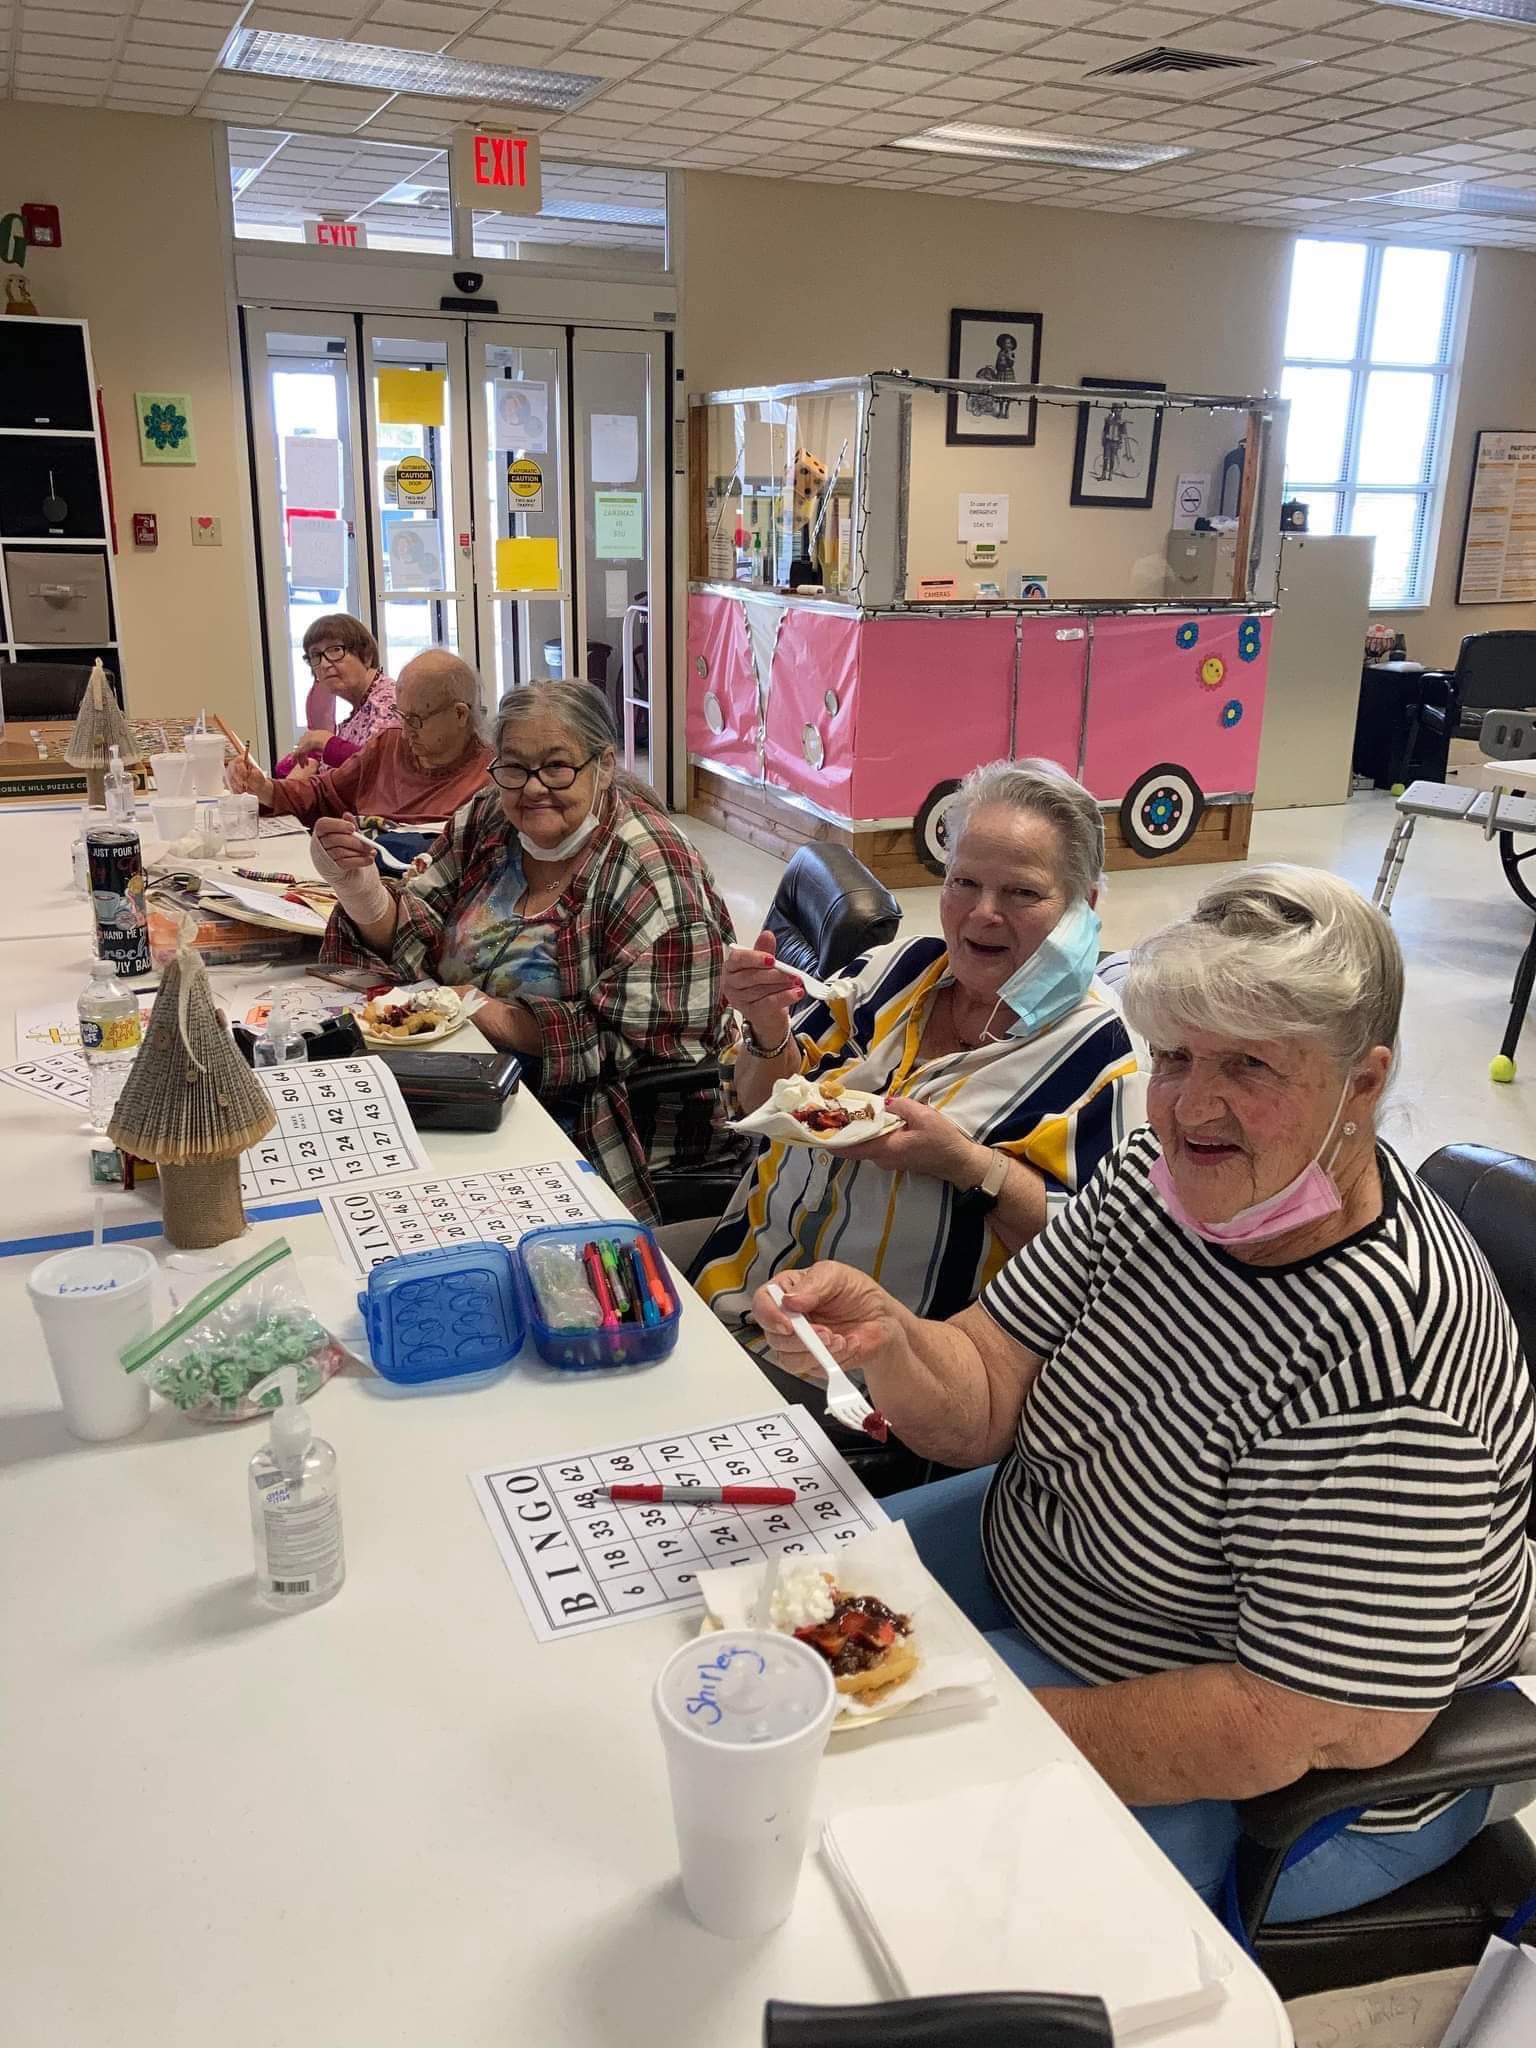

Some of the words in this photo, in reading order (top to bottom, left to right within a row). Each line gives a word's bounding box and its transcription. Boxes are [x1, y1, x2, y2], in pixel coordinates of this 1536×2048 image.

[473, 136, 528, 188] EXIT
[316, 223, 358, 248] EXIT
[93, 847, 109, 858] JUST
[113, 846, 132, 857] POUR
[103, 930, 123, 941] HAND
[309, 1067, 327, 1078] 66
[345, 1063, 362, 1074] 68
[15, 1065, 89, 1099] INGO
[272, 1072, 290, 1082] 64
[318, 1084, 337, 1098] 54
[354, 1080, 372, 1094] 60
[281, 1088, 300, 1102] 50
[327, 1107, 344, 1125] 42
[364, 1103, 379, 1119] 43
[336, 1135, 354, 1151] 24
[373, 1131, 391, 1146] 27
[261, 1147, 280, 1164] 21
[299, 1140, 317, 1158] 23
[346, 1160, 364, 1175] 13
[383, 1154, 401, 1168] 14
[307, 1166, 326, 1181] 12
[498, 1172, 516, 1182] 72
[535, 1166, 553, 1176] 75
[270, 1177, 287, 1186] 7
[461, 1179, 479, 1189] 71
[544, 1179, 563, 1189] 60
[385, 1190, 402, 1200] 63
[423, 1184, 441, 1194] 70
[507, 1185, 525, 1196] 58
[431, 1197, 448, 1208] 53
[469, 1193, 487, 1202] 57
[516, 1199, 534, 1209] 44
[554, 1193, 573, 1203] 45
[392, 1203, 409, 1214] 46
[565, 1207, 584, 1218] 30
[400, 1219, 418, 1229] 31
[438, 1212, 457, 1223] 35
[487, 1219, 506, 1230] 23
[526, 1215, 545, 1225] 27
[343, 1195, 396, 1266] BINGO
[447, 1226, 466, 1238] 20
[407, 1233, 425, 1244] 16
[496, 1234, 515, 1245] 10
[756, 1423, 781, 1440] 73
[708, 1433, 734, 1451] 72
[660, 1445, 685, 1463] 70
[774, 1447, 800, 1464] 60
[610, 1455, 634, 1472] 68
[725, 1460, 751, 1476] 59
[560, 1465, 585, 1482] 62
[675, 1472, 702, 1488] 57
[792, 1475, 820, 1492] 37
[574, 1492, 598, 1509] 48
[813, 1501, 842, 1520] 28
[640, 1508, 667, 1528] 35
[763, 1513, 791, 1533] 26
[588, 1519, 615, 1539] 33
[710, 1526, 739, 1546] 24
[506, 1475, 600, 1617] BINGO
[657, 1540, 683, 1558] 19
[783, 1542, 806, 1555] 3
[604, 1549, 630, 1570] 18
[730, 1556, 750, 1566] 1
[622, 1585, 645, 1595] 6
[684, 1646, 766, 1725] Shirley
